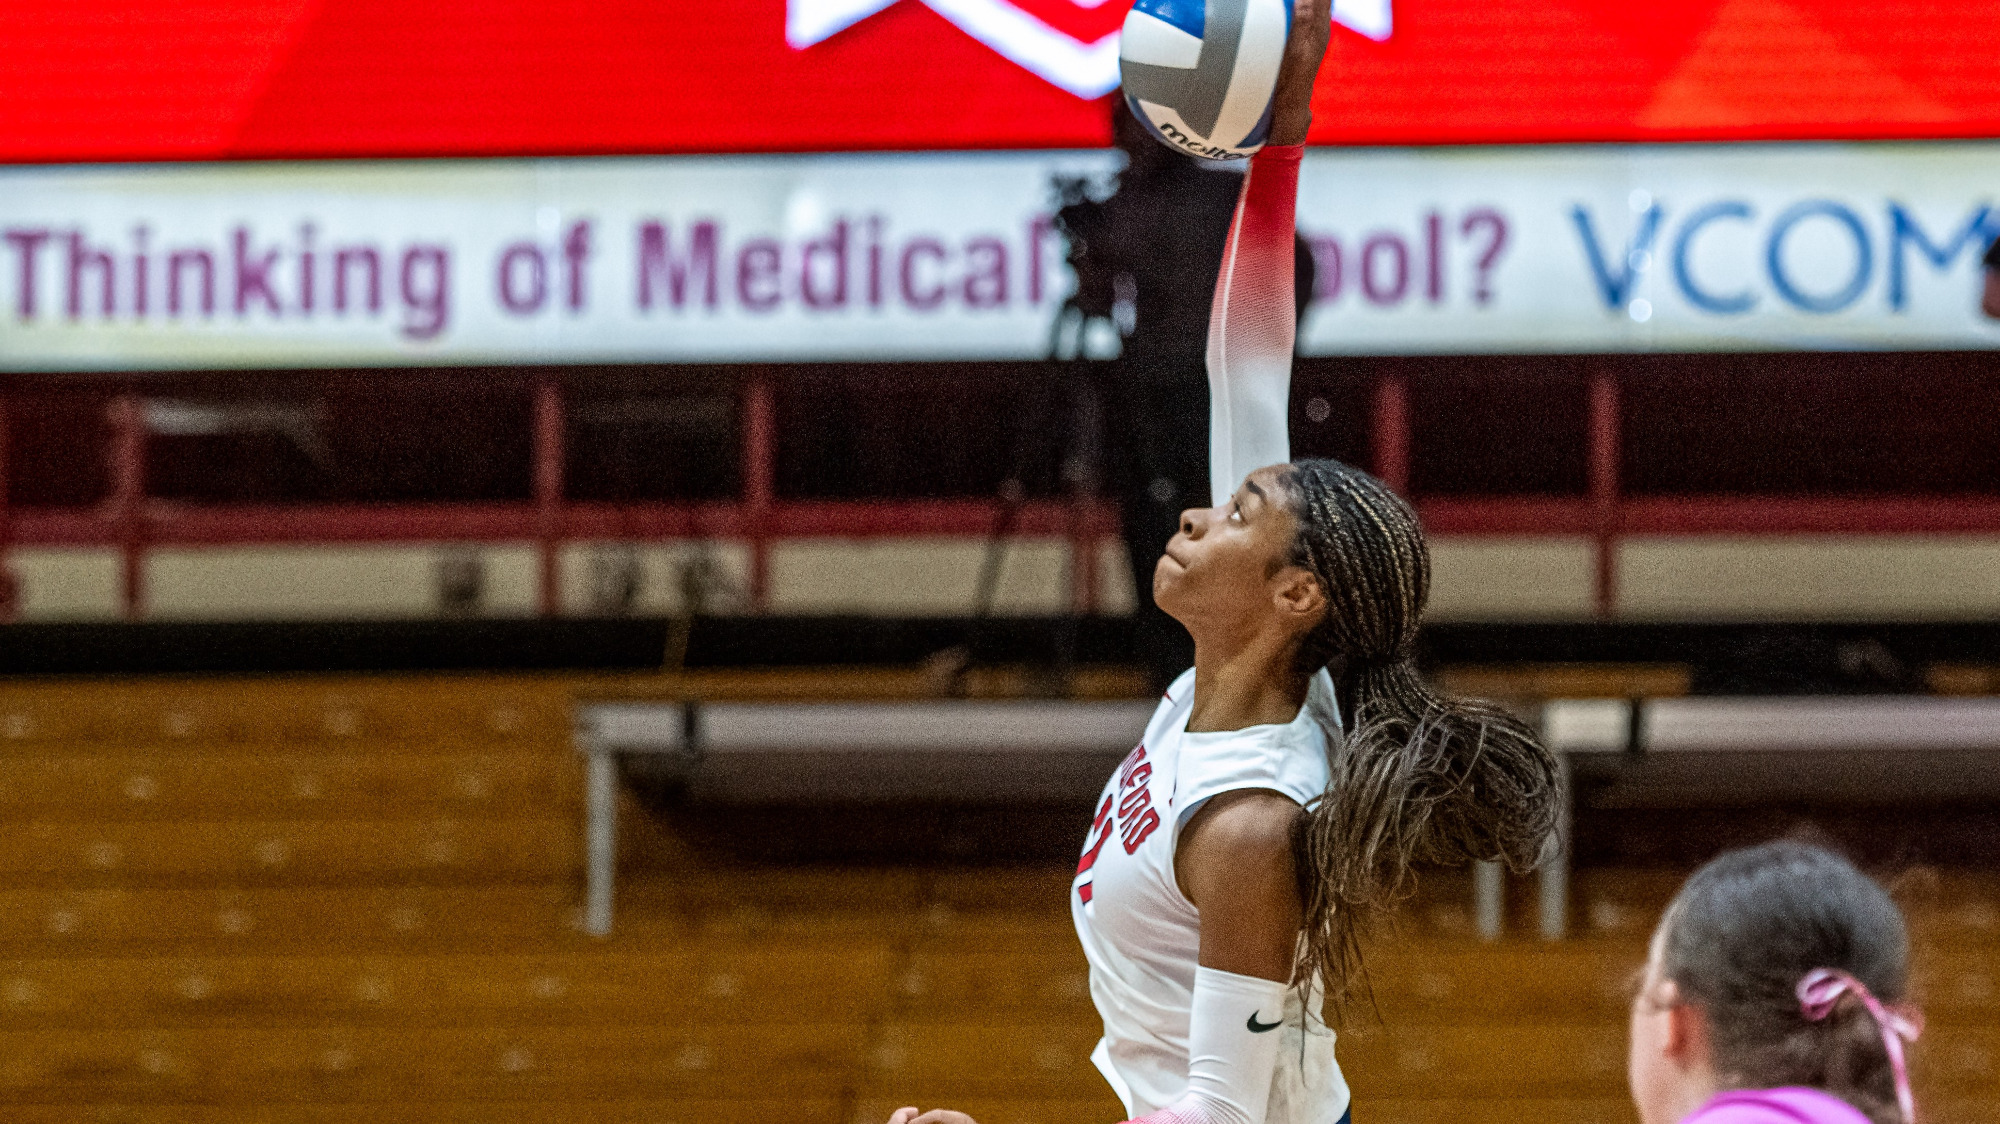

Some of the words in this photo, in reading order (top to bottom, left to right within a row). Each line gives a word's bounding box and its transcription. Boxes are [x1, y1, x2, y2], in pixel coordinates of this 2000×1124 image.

[1160, 122, 1247, 159] molte
[3, 222, 449, 338] Thinking
[496, 217, 594, 313] of
[638, 216, 1047, 310] Medical
[1306, 208, 1513, 306] ool?
[1570, 200, 1996, 313] VCOM
